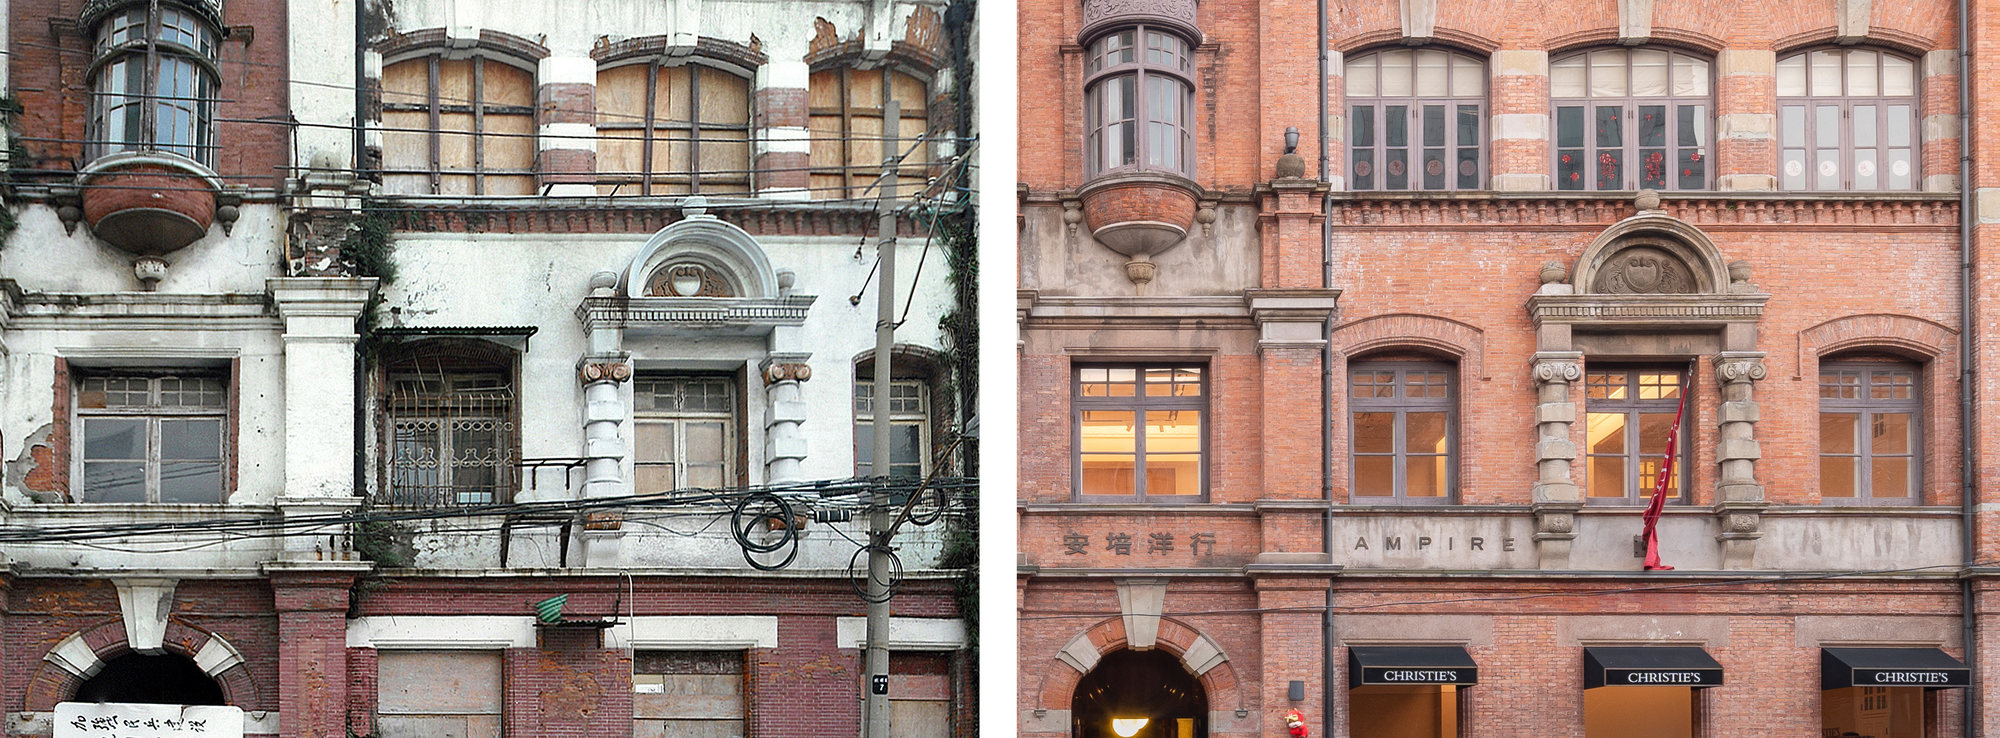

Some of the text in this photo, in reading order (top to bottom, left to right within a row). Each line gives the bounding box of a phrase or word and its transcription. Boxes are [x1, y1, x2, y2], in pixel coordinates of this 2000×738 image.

[1063, 532, 1217, 556] 安培洋行
[1354, 536, 1515, 552] AMPIRE
[1383, 670, 1457, 682] CHRISTIE'S
[1627, 672, 1701, 683] CHRISTIE'S
[1874, 671, 1949, 683] CHRISTIE'S
